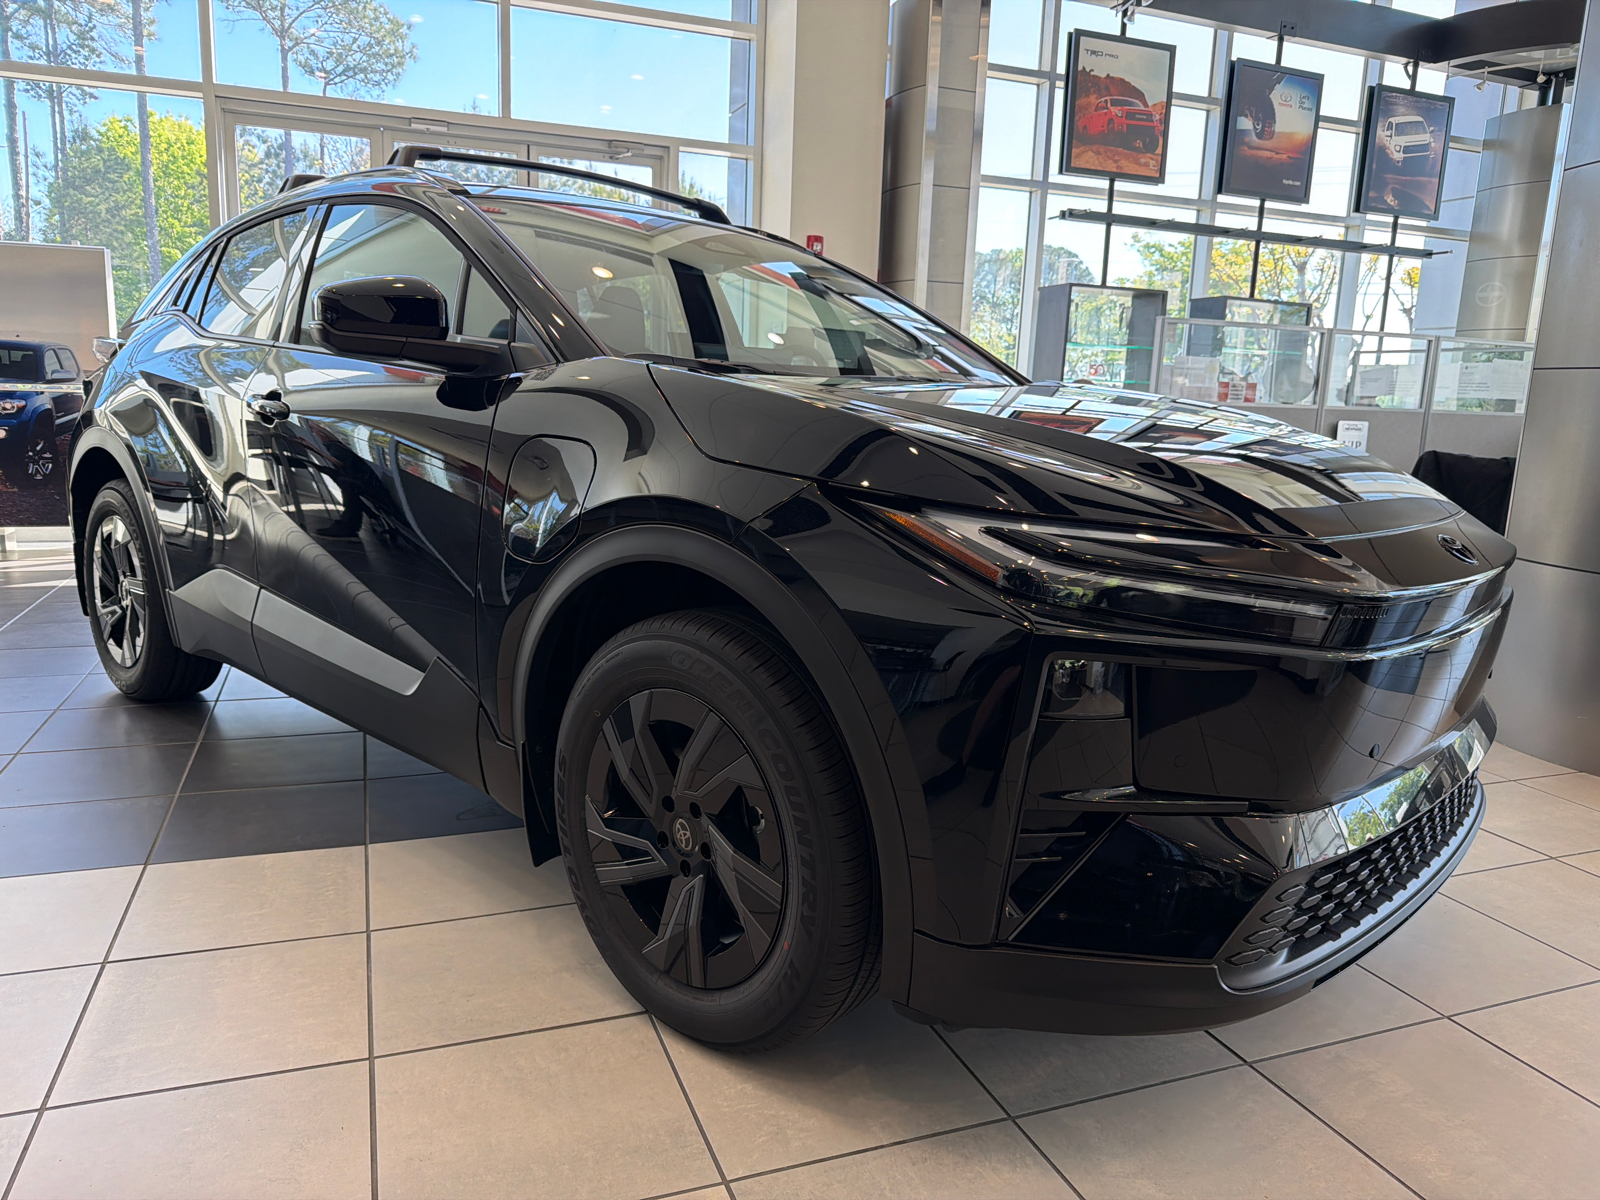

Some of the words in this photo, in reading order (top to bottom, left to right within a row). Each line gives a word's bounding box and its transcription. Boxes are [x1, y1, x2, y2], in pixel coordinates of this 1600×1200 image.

[1084, 48, 1104, 58] TRD
[556, 753, 574, 858] TIRES
[668, 649, 757, 717] OPEN
[757, 728, 818, 940] COUNTRY
